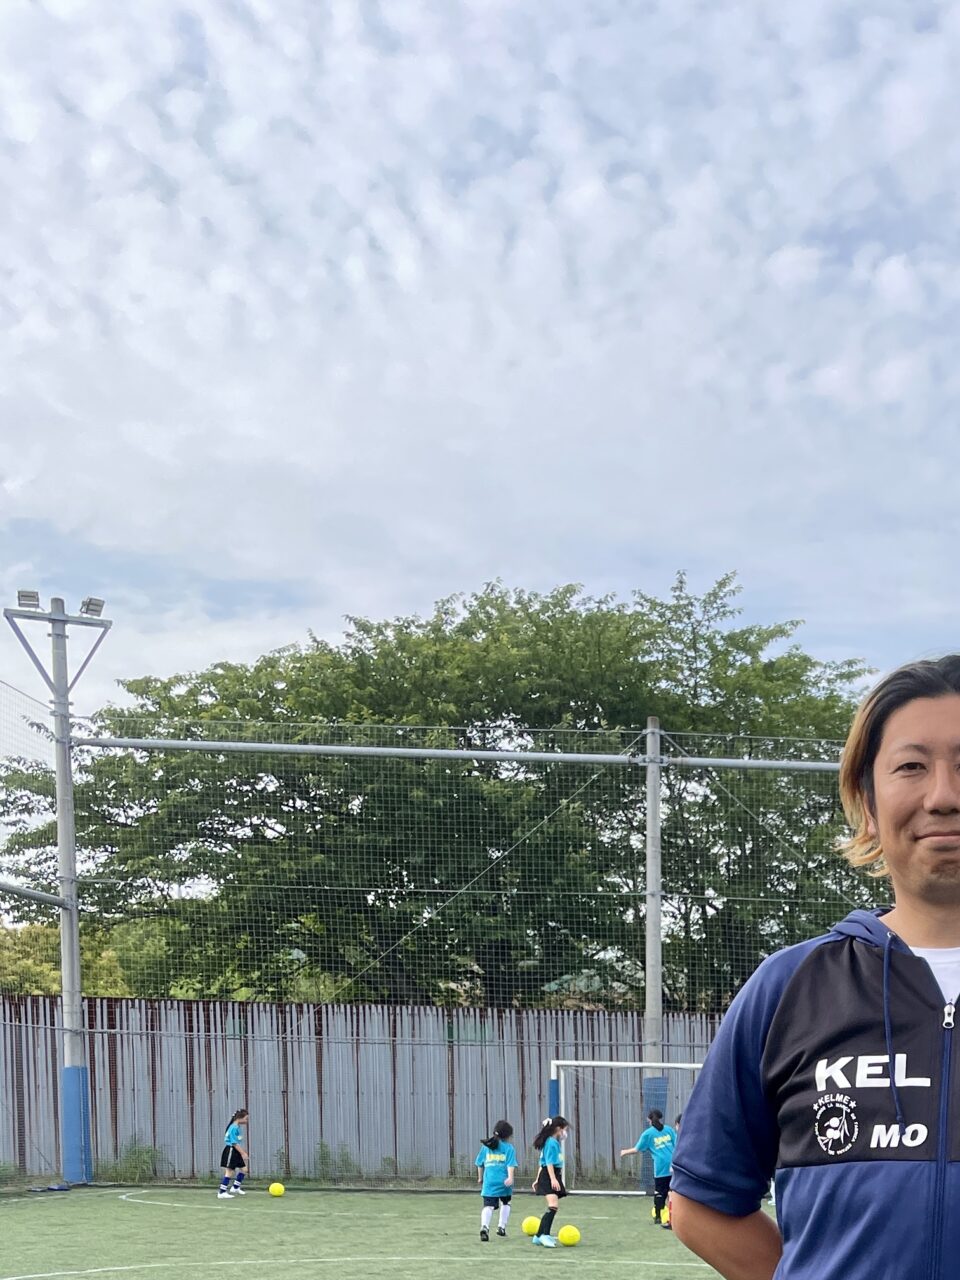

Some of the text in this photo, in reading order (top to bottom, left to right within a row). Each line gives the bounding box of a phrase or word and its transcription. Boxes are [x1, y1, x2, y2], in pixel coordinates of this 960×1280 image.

[815, 1053, 931, 1092] KEL
[817, 1093, 851, 1106] KELME
[870, 1123, 928, 1148] MO
